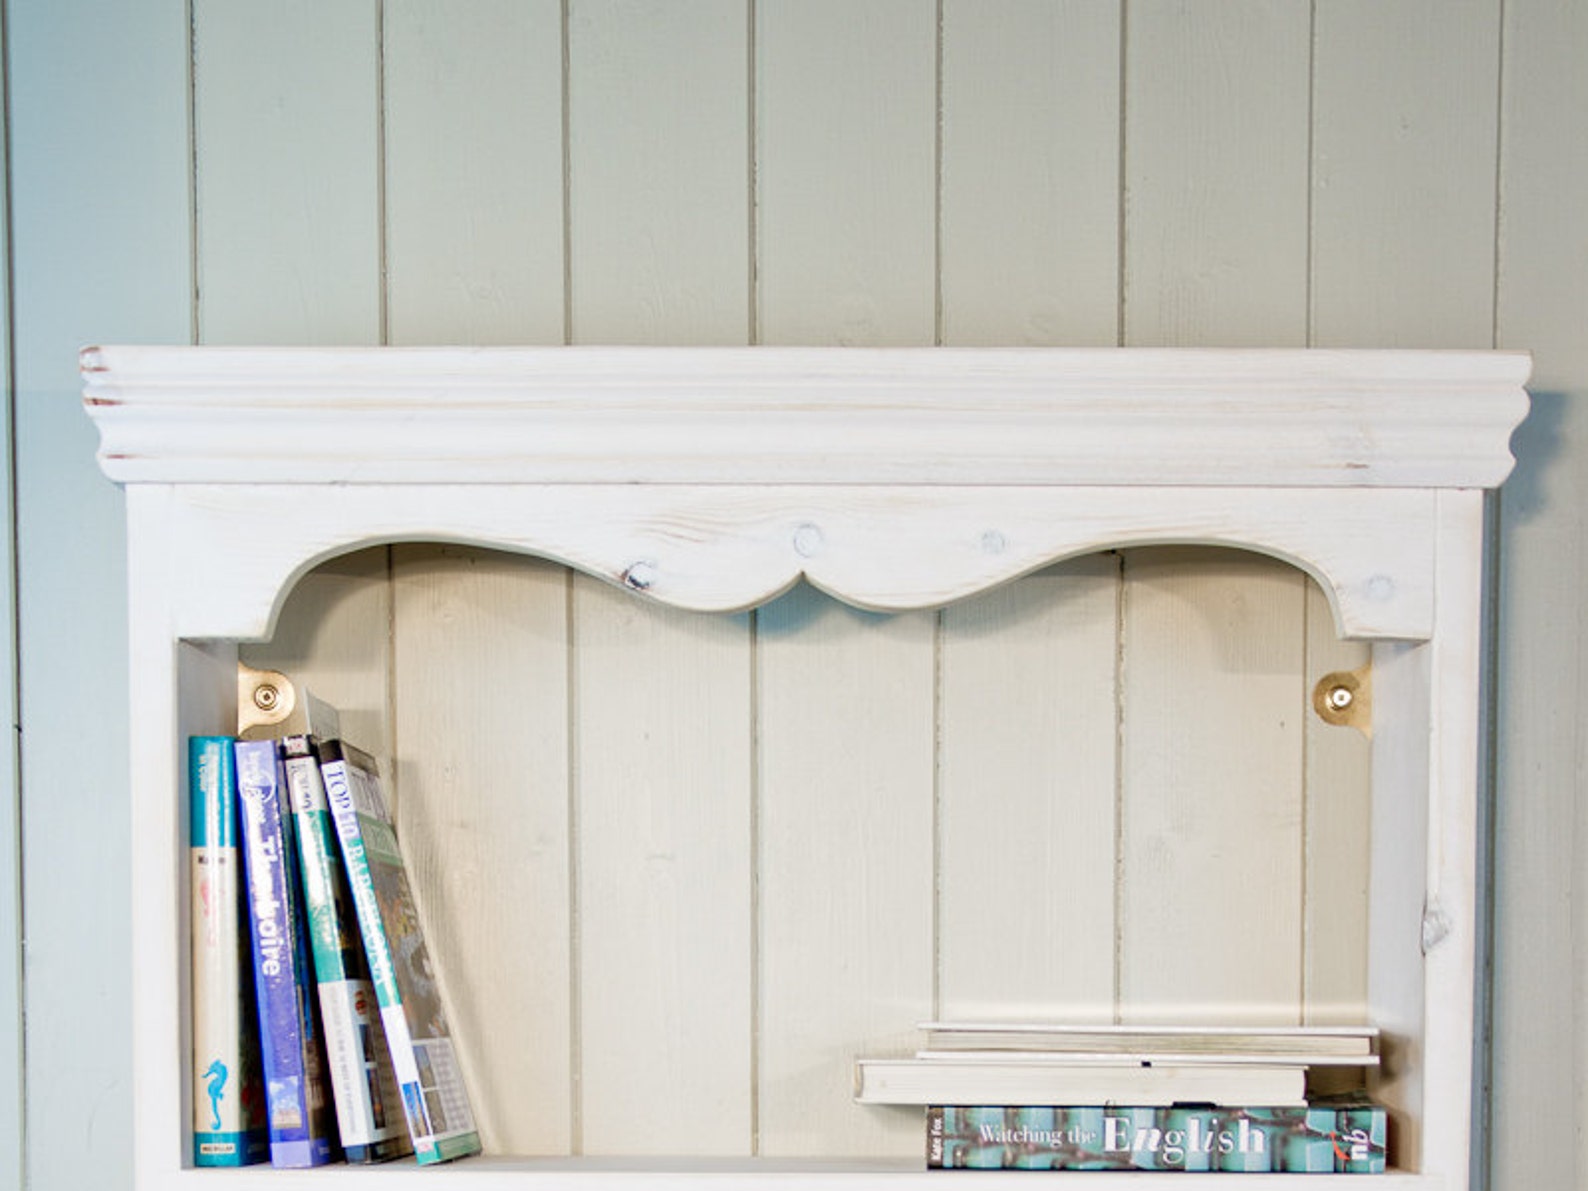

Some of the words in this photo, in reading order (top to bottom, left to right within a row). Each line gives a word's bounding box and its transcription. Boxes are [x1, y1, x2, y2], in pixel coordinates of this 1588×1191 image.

[325, 766, 350, 809] TOP
[979, 1124, 1063, 1148] Watching
[1067, 1125, 1096, 1144] the
[1103, 1117, 1265, 1165] English
